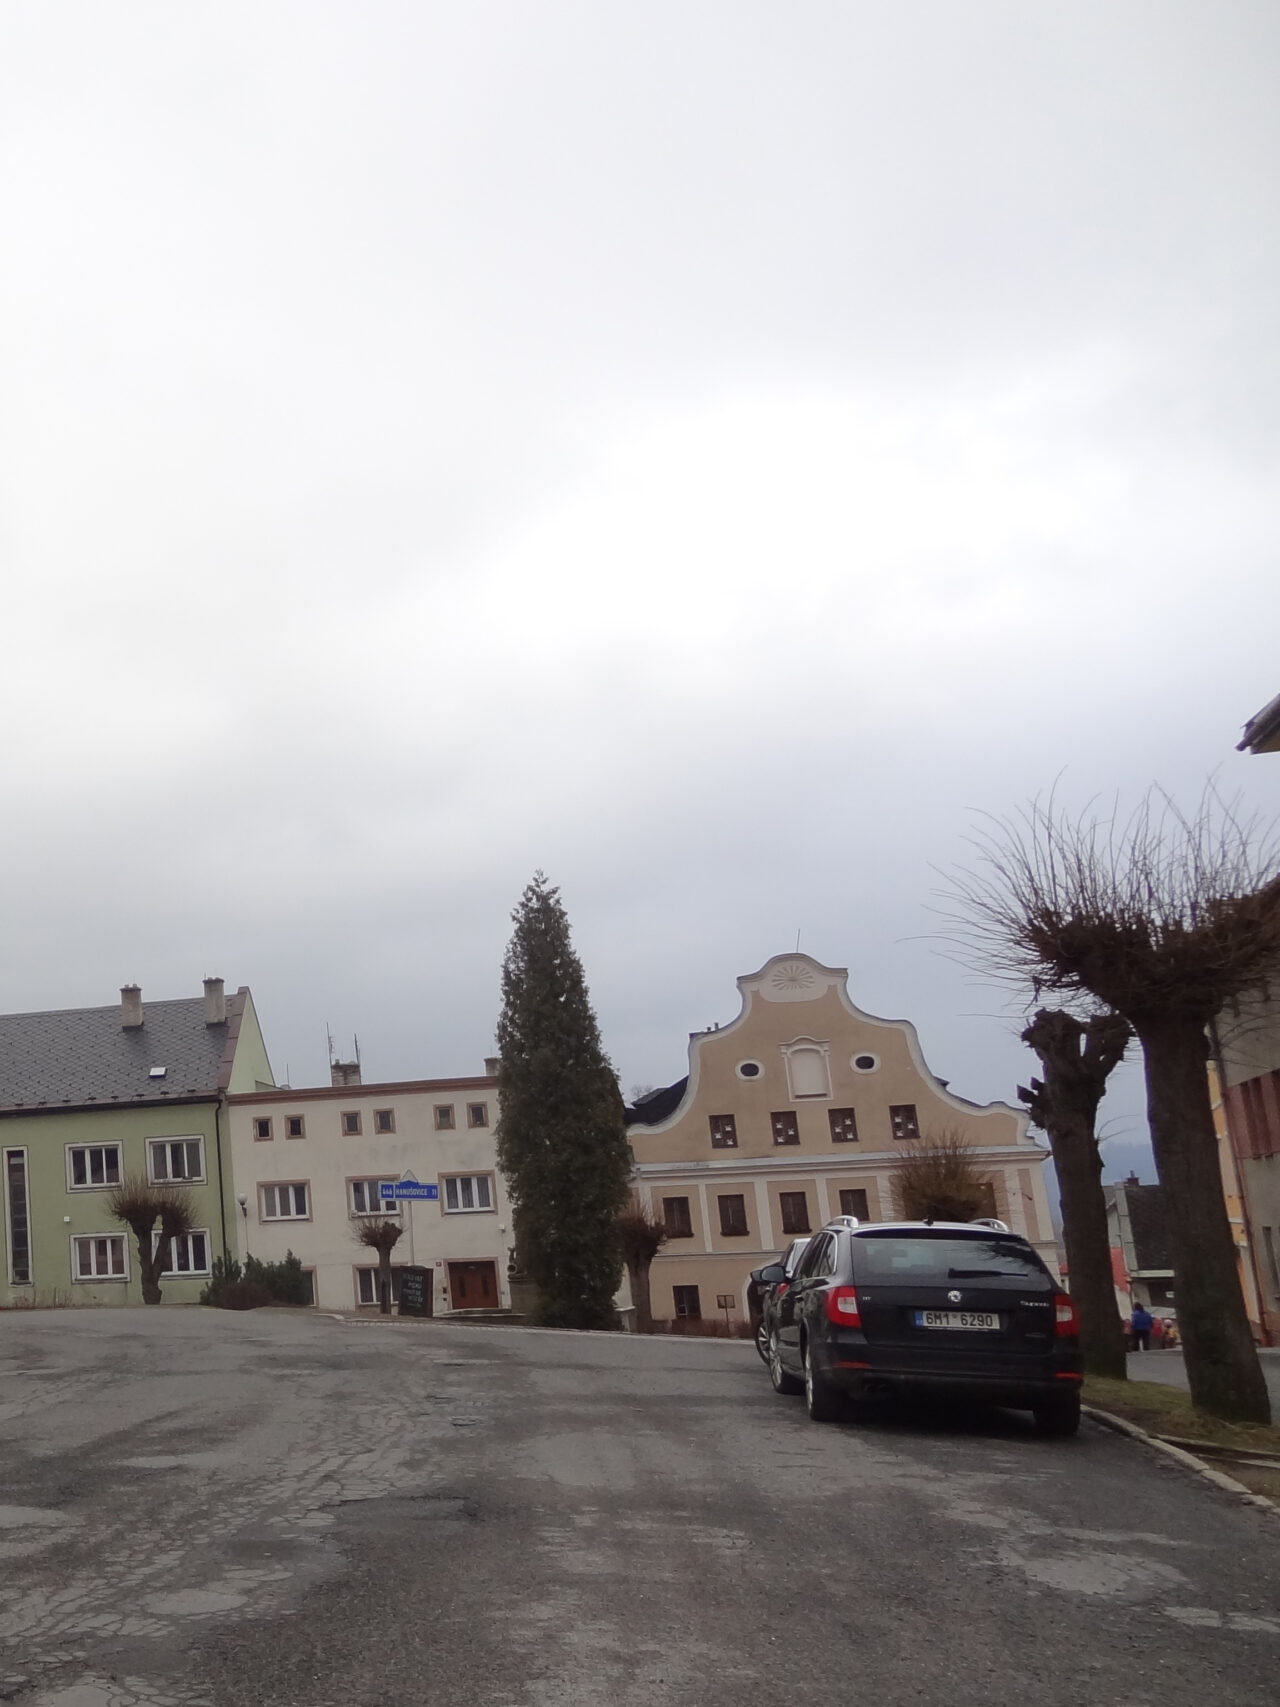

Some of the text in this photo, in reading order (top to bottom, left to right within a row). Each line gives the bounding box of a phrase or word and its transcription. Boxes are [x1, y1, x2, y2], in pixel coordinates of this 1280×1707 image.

[395, 1187, 428, 1196] HANUŠOVICE
[926, 1312, 951, 1325] 6M1
[961, 1313, 993, 1327] 6290
